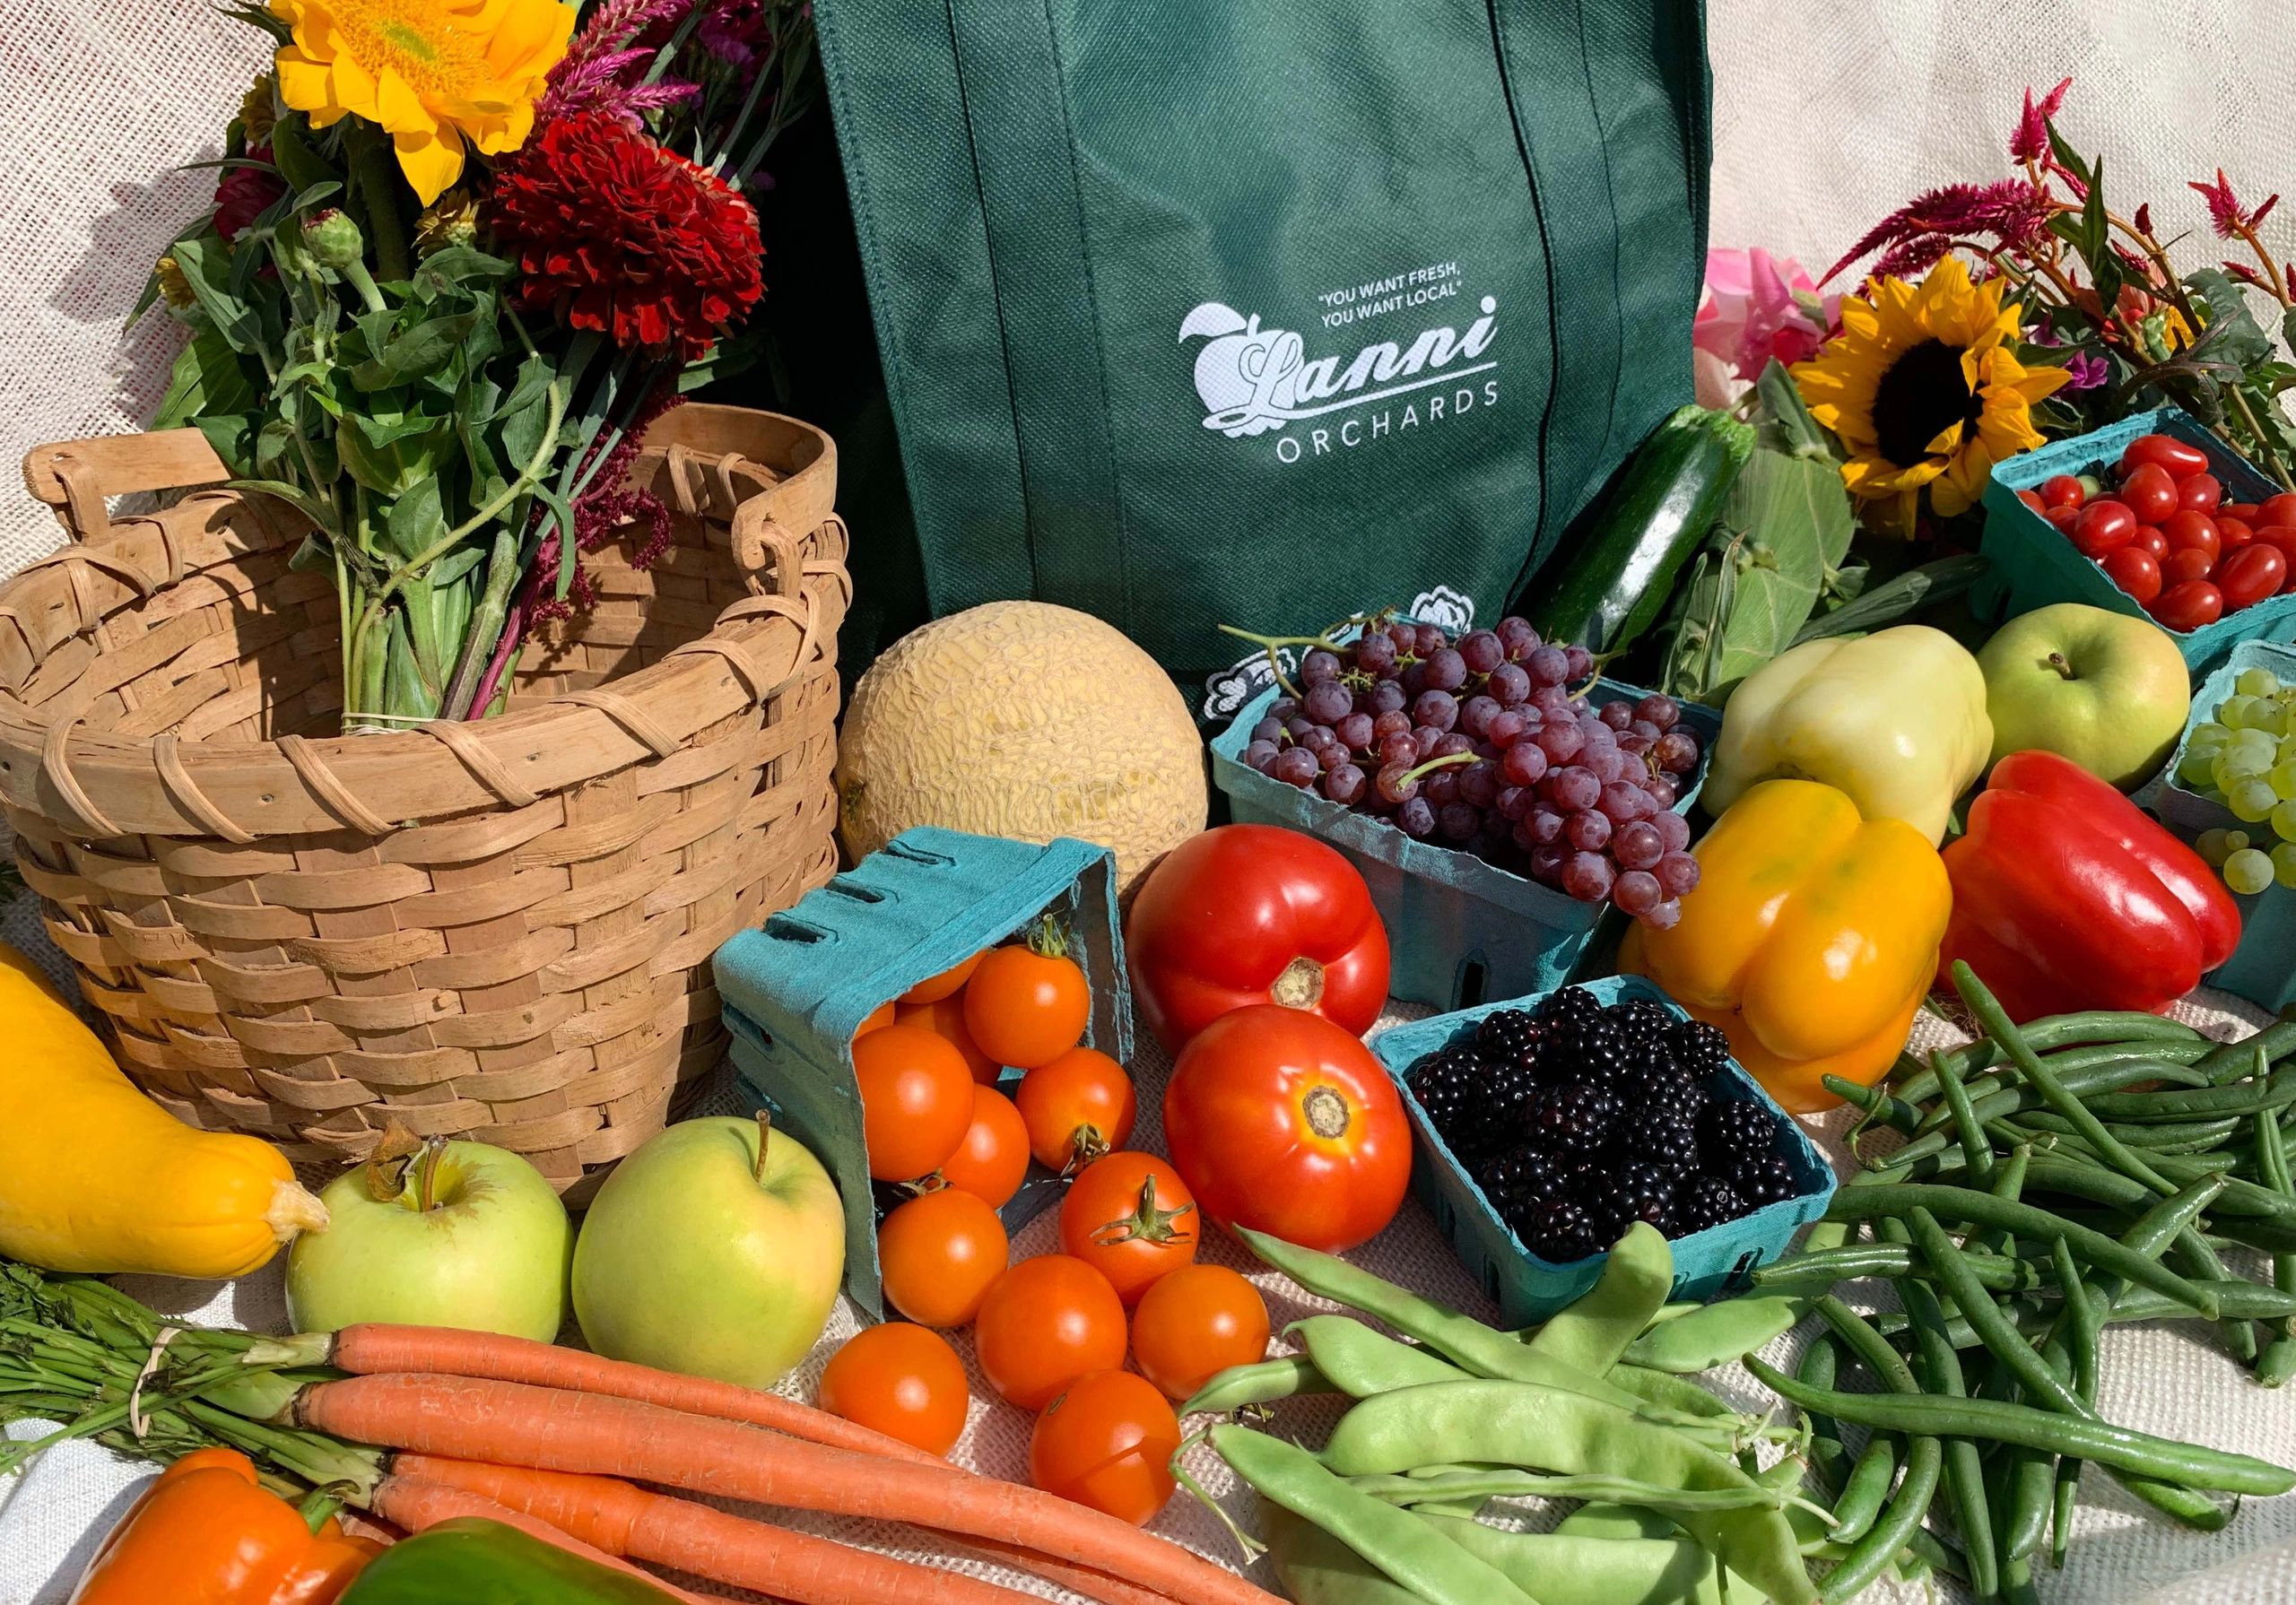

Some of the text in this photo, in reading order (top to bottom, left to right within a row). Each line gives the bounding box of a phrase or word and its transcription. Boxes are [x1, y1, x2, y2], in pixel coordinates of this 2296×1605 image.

[1318, 262, 1461, 307] "YOU WANT FRESH,
[1321, 281, 1461, 328] YOU WANT LOCAL"
[1202, 296, 1498, 429] Lanni
[1276, 381, 1498, 464] ORCHARDS
